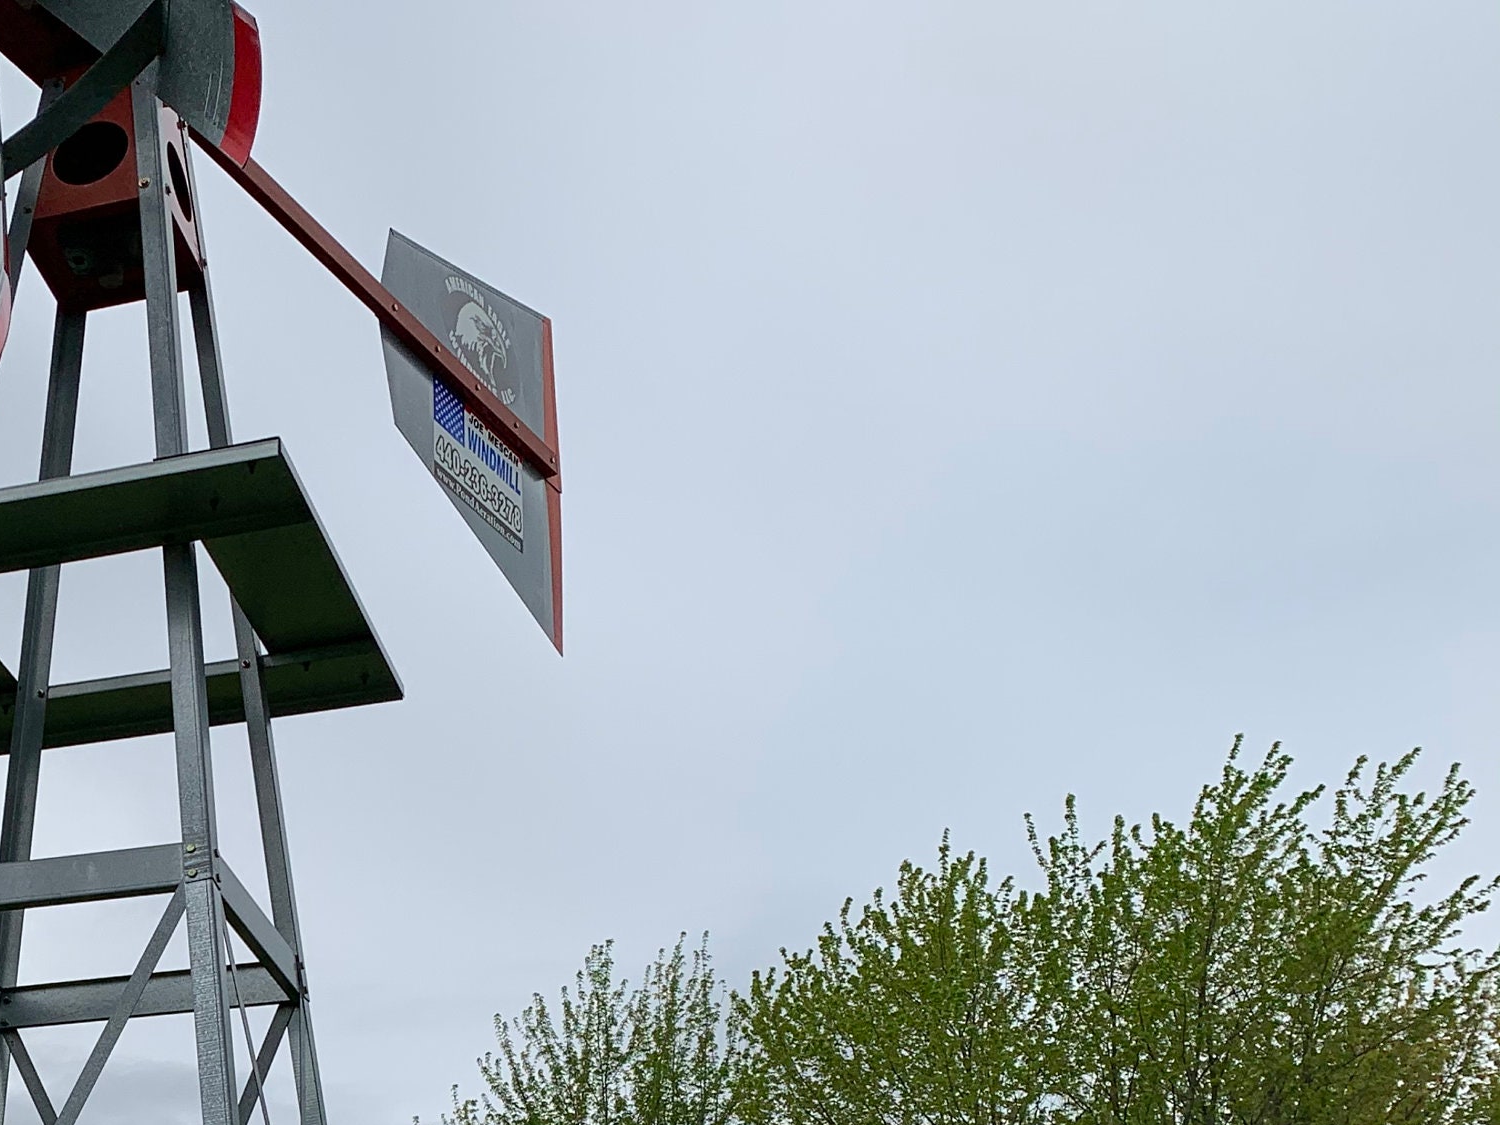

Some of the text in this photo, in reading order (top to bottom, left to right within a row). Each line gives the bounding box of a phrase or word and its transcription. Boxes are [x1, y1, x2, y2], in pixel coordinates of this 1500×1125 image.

[445, 276, 511, 349] AMERICAN EAGLE
[467, 426, 521, 496] WINDMILL
[469, 412, 520, 468] JOE MESCAN
[435, 434, 522, 533] 440-236-3278
[436, 468, 521, 550] www.PondAeration.com
